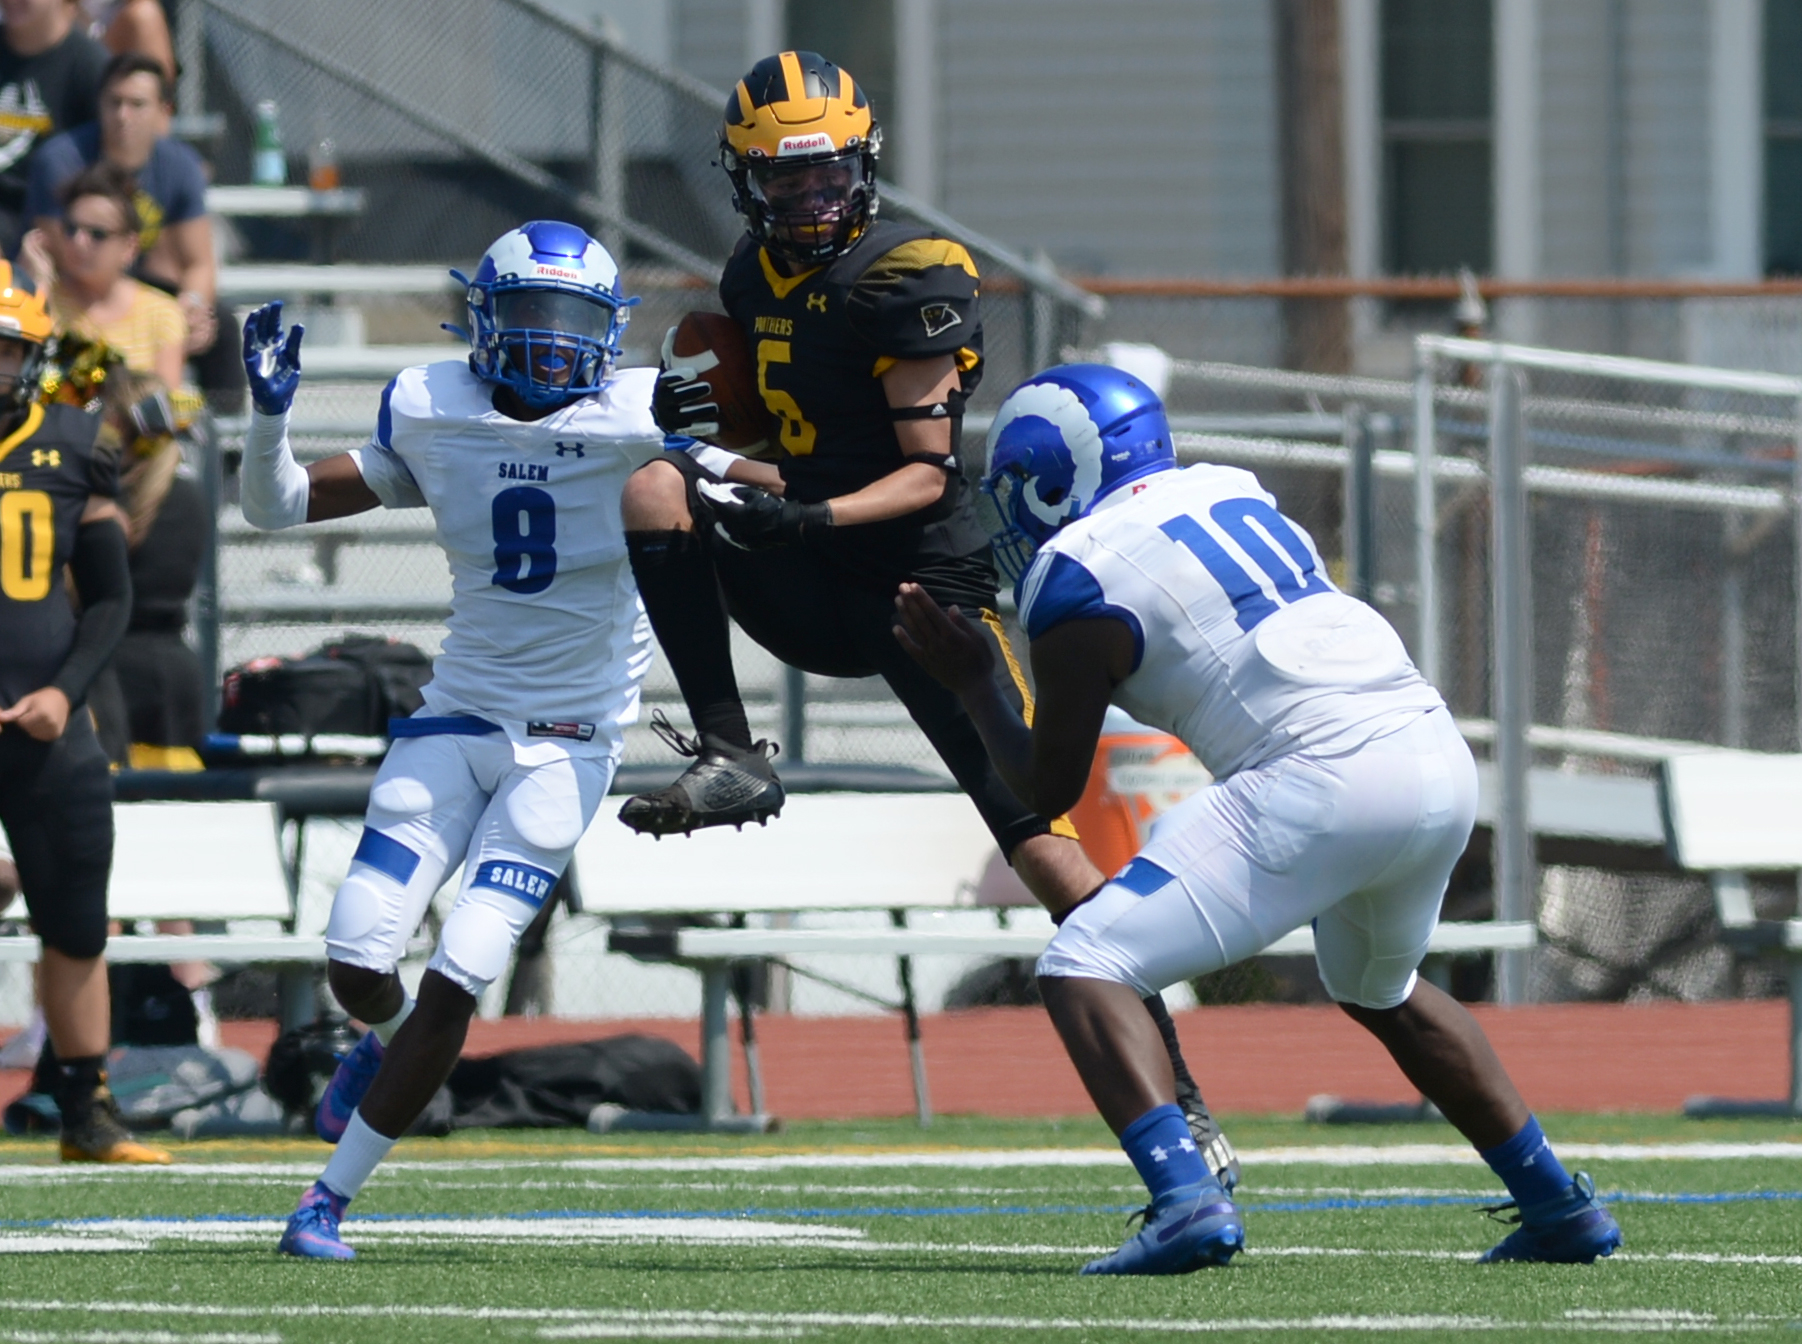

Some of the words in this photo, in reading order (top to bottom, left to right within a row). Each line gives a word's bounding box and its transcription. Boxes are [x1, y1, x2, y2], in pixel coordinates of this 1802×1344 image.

[784, 136, 826, 150] Riddell
[498, 462, 549, 482] SALEM
[1, 490, 53, 601] 0
[492, 486, 557, 595] 8
[1157, 497, 1335, 634] 10
